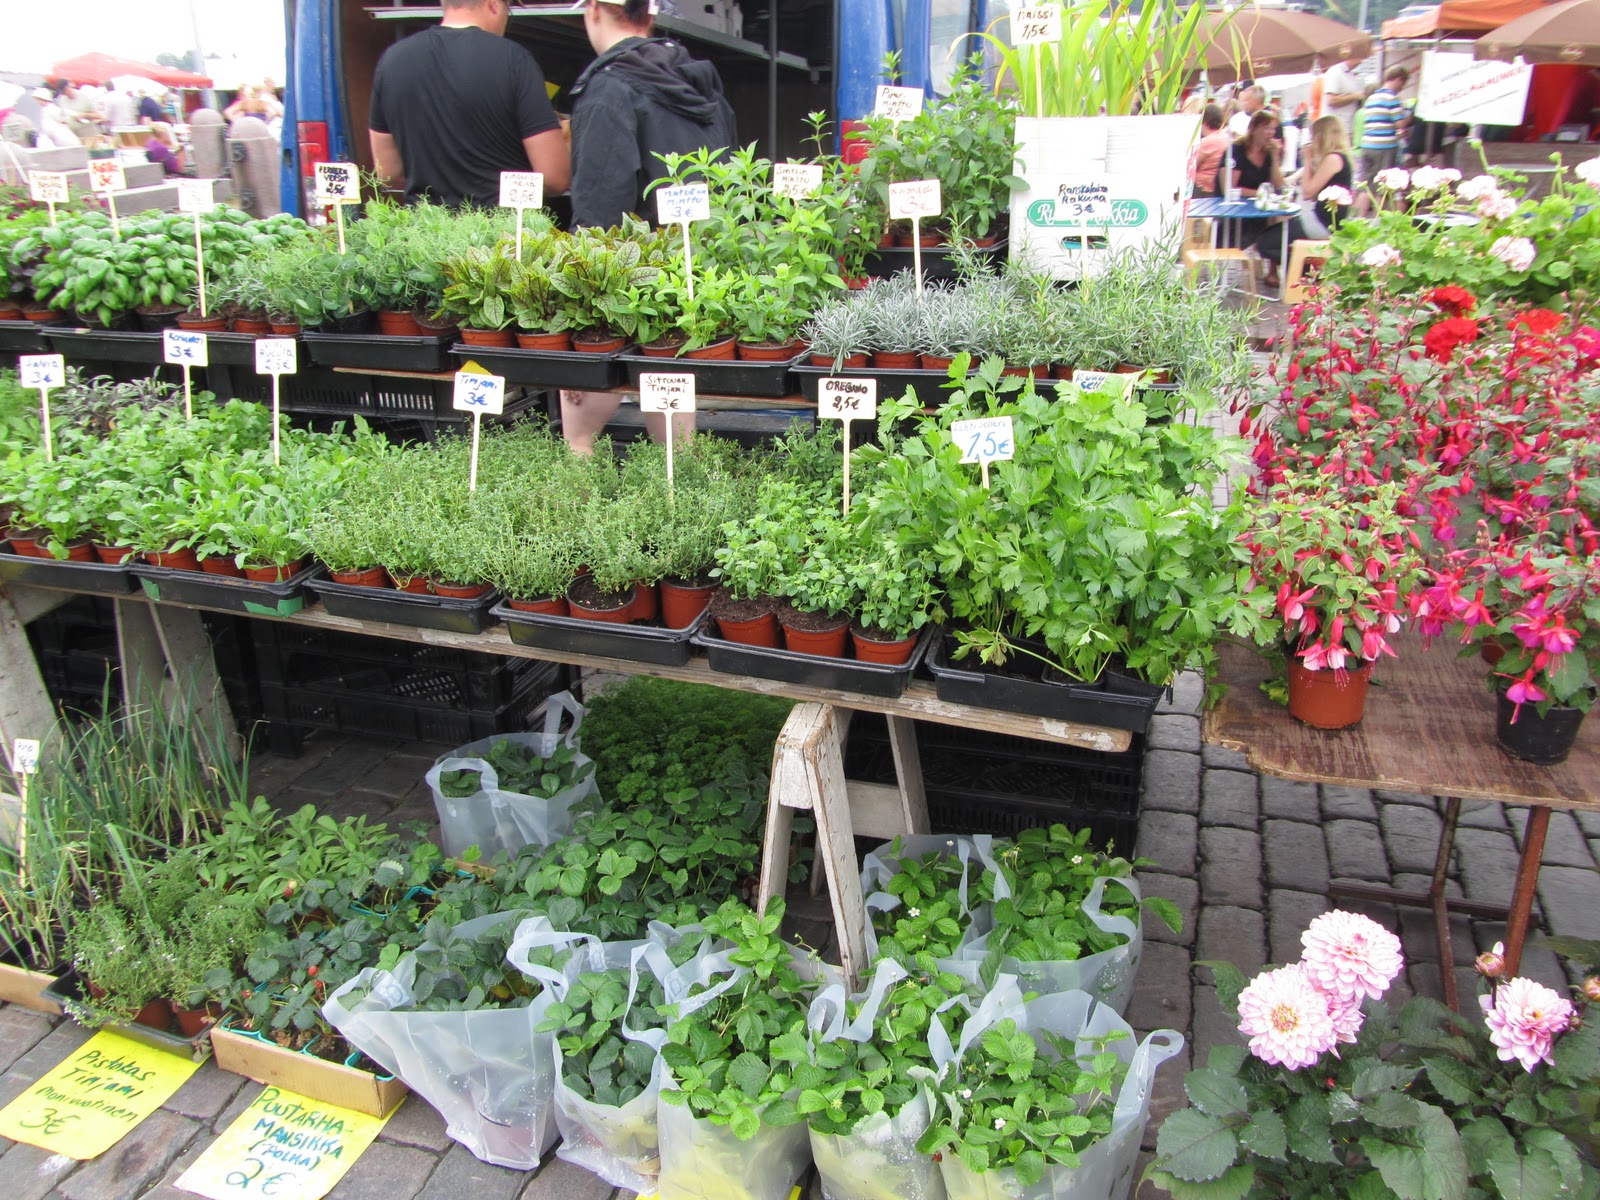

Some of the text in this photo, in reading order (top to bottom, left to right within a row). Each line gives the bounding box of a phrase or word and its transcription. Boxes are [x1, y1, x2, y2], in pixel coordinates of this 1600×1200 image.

[1022, 24, 1049, 40] 1,5€
[671, 206, 694, 218] 3€
[1072, 203, 1096, 217] 3€
[169, 345, 195, 358] 3€
[30, 371, 54, 384] 3€
[464, 391, 489, 405] 3€
[656, 397, 680, 410] 3€
[832, 395, 861, 412] 2,5€
[19, 1107, 81, 1135] 3€
[253, 1117, 344, 1159] MANSIKKA
